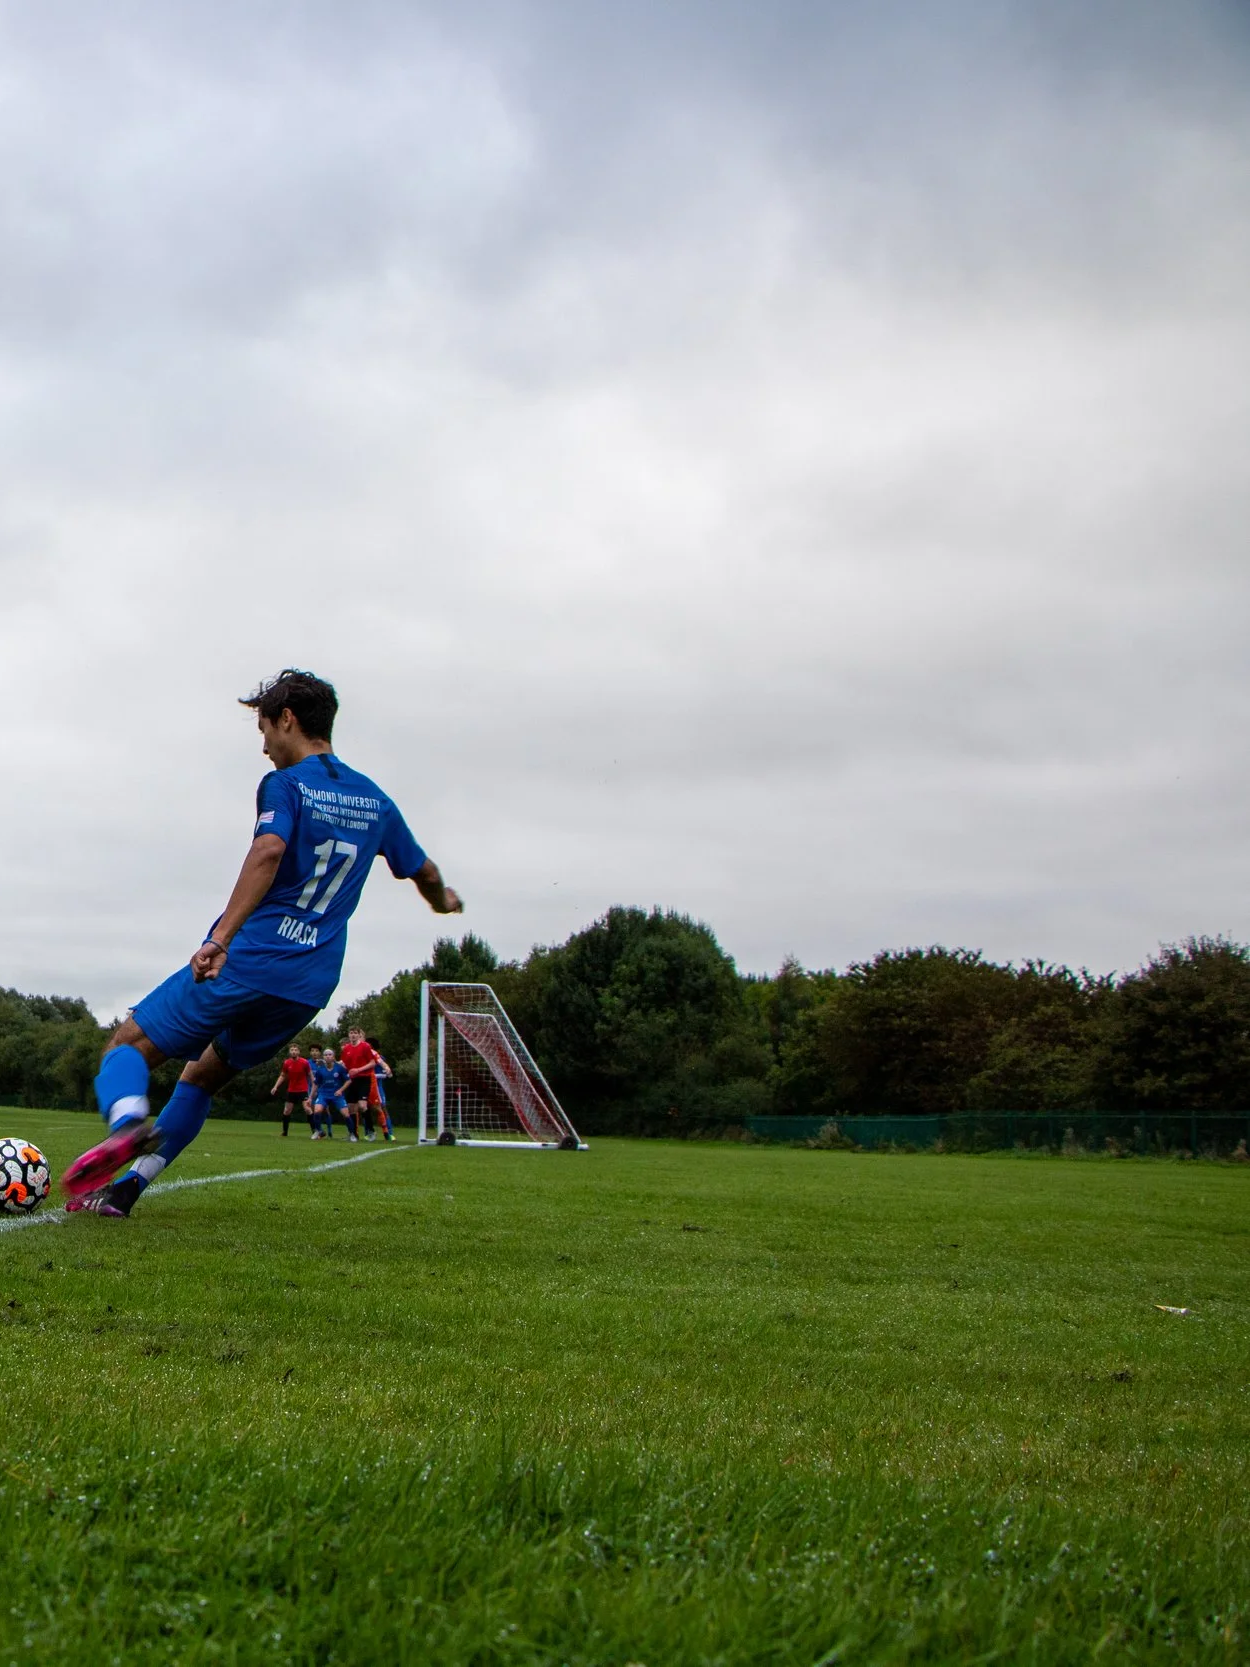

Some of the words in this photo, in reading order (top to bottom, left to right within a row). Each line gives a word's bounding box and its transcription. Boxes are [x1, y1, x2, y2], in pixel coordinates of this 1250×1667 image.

[298, 783, 336, 803] RIHMOND
[338, 793, 379, 810] UNIVERSITY
[302, 797, 313, 807] THE
[340, 806, 378, 820] INTERNATIONAL
[311, 809, 340, 824] UNIVERSITY
[347, 819, 369, 831] LONDON
[296, 839, 357, 915] 17
[277, 915, 318, 947] RIASA
